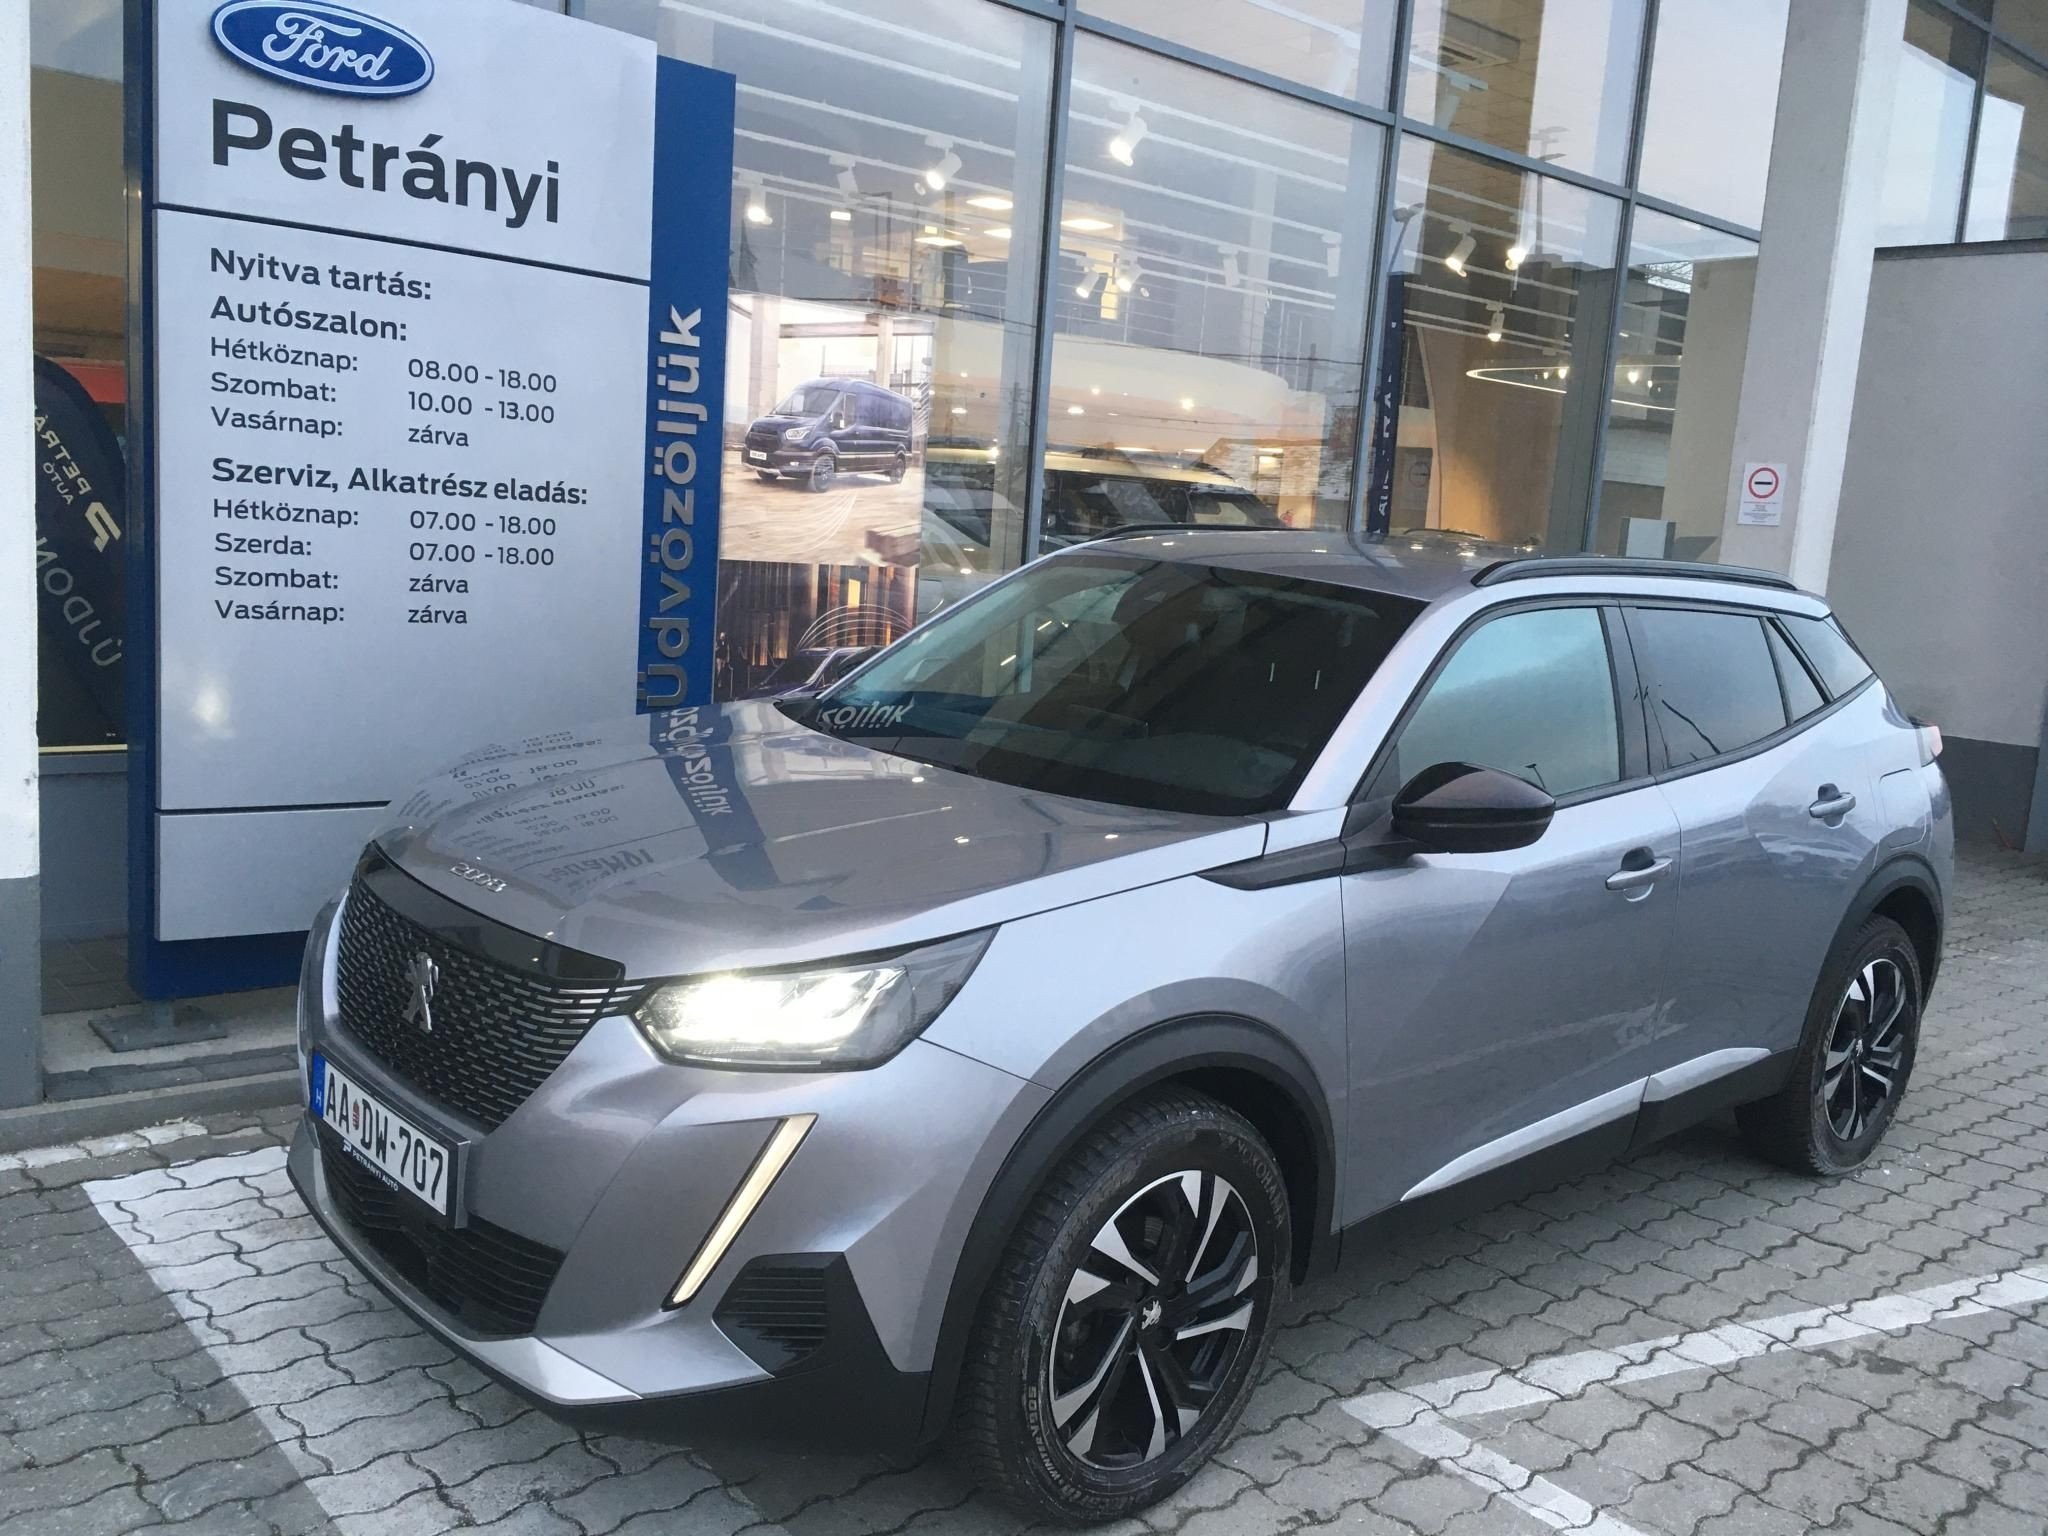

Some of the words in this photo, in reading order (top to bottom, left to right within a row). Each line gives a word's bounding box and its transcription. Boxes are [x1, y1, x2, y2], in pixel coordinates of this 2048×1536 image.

[262, 12, 394, 81] Ford
[213, 98, 560, 229] Petrányi
[210, 247, 321, 286] Nyitva
[327, 264, 431, 301] tartás:
[209, 295, 408, 343] Autószalon:
[210, 336, 358, 374] Hétköznap:
[408, 358, 479, 385] 08.00
[210, 371, 336, 403] Szombat:
[408, 390, 473, 416] 10.00
[210, 405, 343, 439] Vasárnap:
[407, 424, 470, 448] zárva
[211, 457, 339, 494] Szerviz,
[347, 467, 488, 499] Alkatrész
[493, 477, 588, 505] eladás:
[213, 498, 359, 529] Hétköznap:
[409, 509, 476, 532] 07.00
[637, 304, 708, 707] Üdvözöljük
[214, 532, 312, 556] Szerda:
[409, 542, 476, 563] 07.00
[214, 565, 339, 590] Szombat:
[408, 573, 470, 594] zárva
[214, 599, 345, 625] Vasárnap:
[407, 604, 468, 625] zárva
[450, 862, 507, 892] 2008
